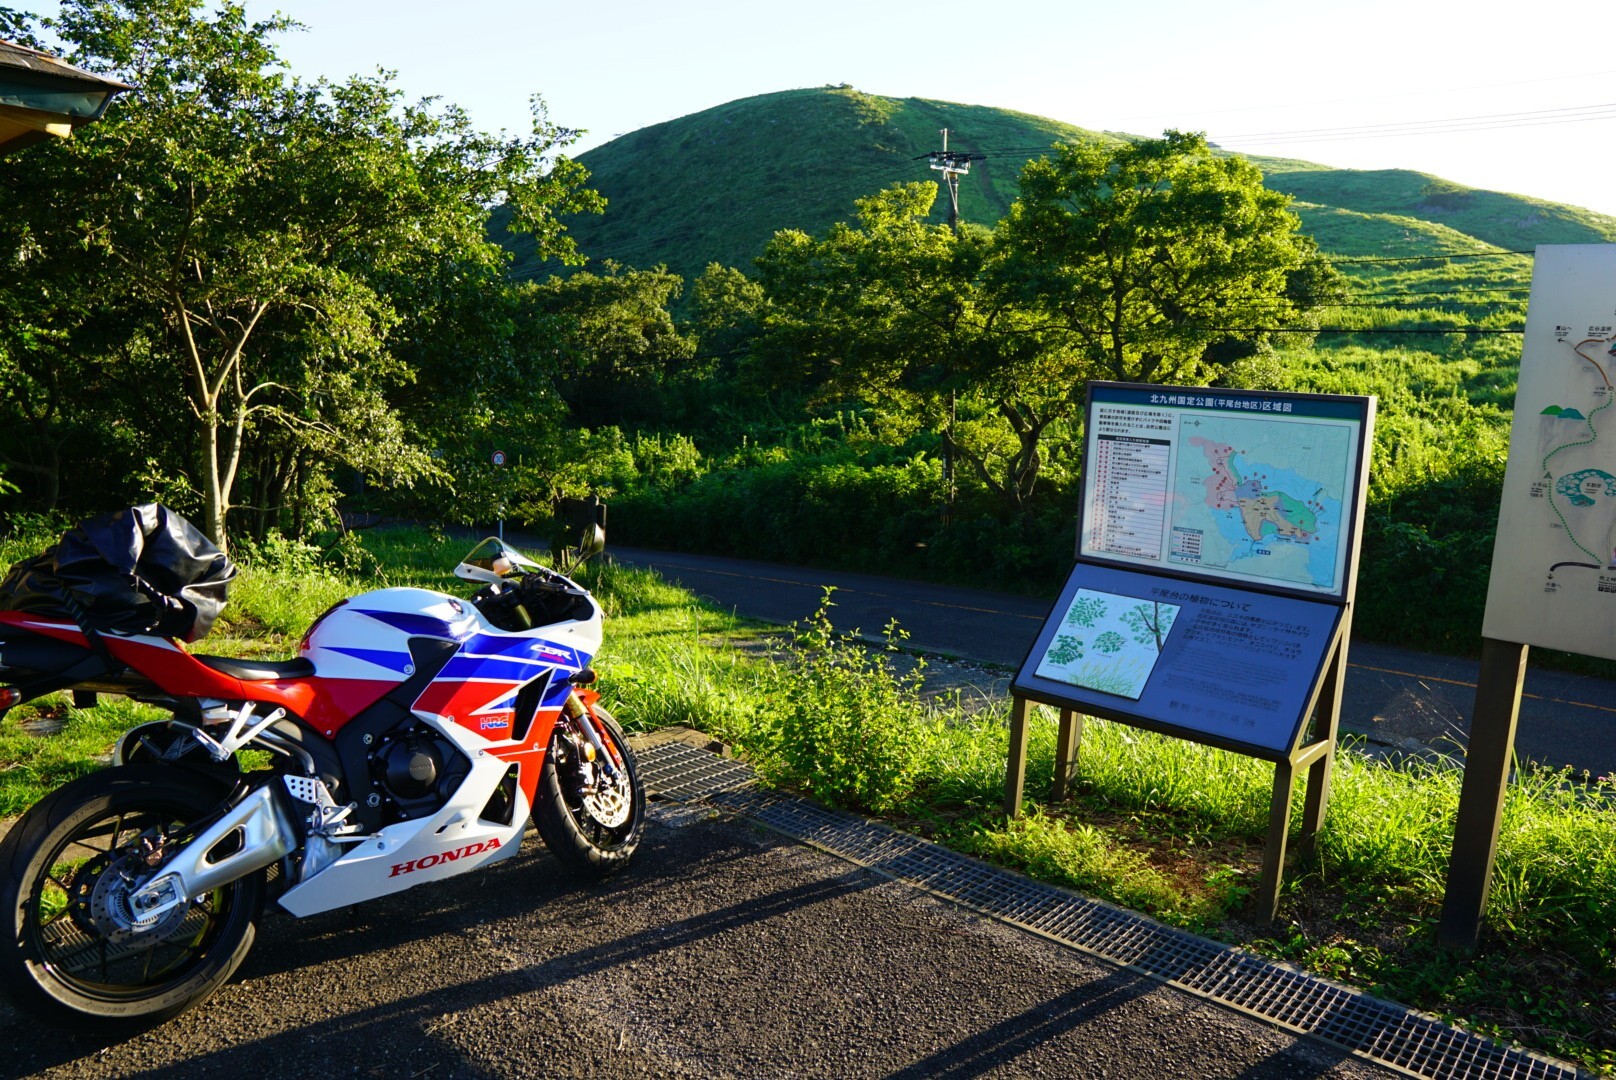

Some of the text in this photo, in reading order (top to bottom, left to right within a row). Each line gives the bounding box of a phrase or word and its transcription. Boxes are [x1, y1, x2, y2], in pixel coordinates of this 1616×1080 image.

[1150, 394, 1293, 413] 北九州国定公園(平尾台地区)区域図
[1151, 587, 1252, 611] 平尾台の植物について
[530, 643, 572, 661] CBR
[480, 715, 509, 730] HRC
[387, 837, 502, 878] HONDA
